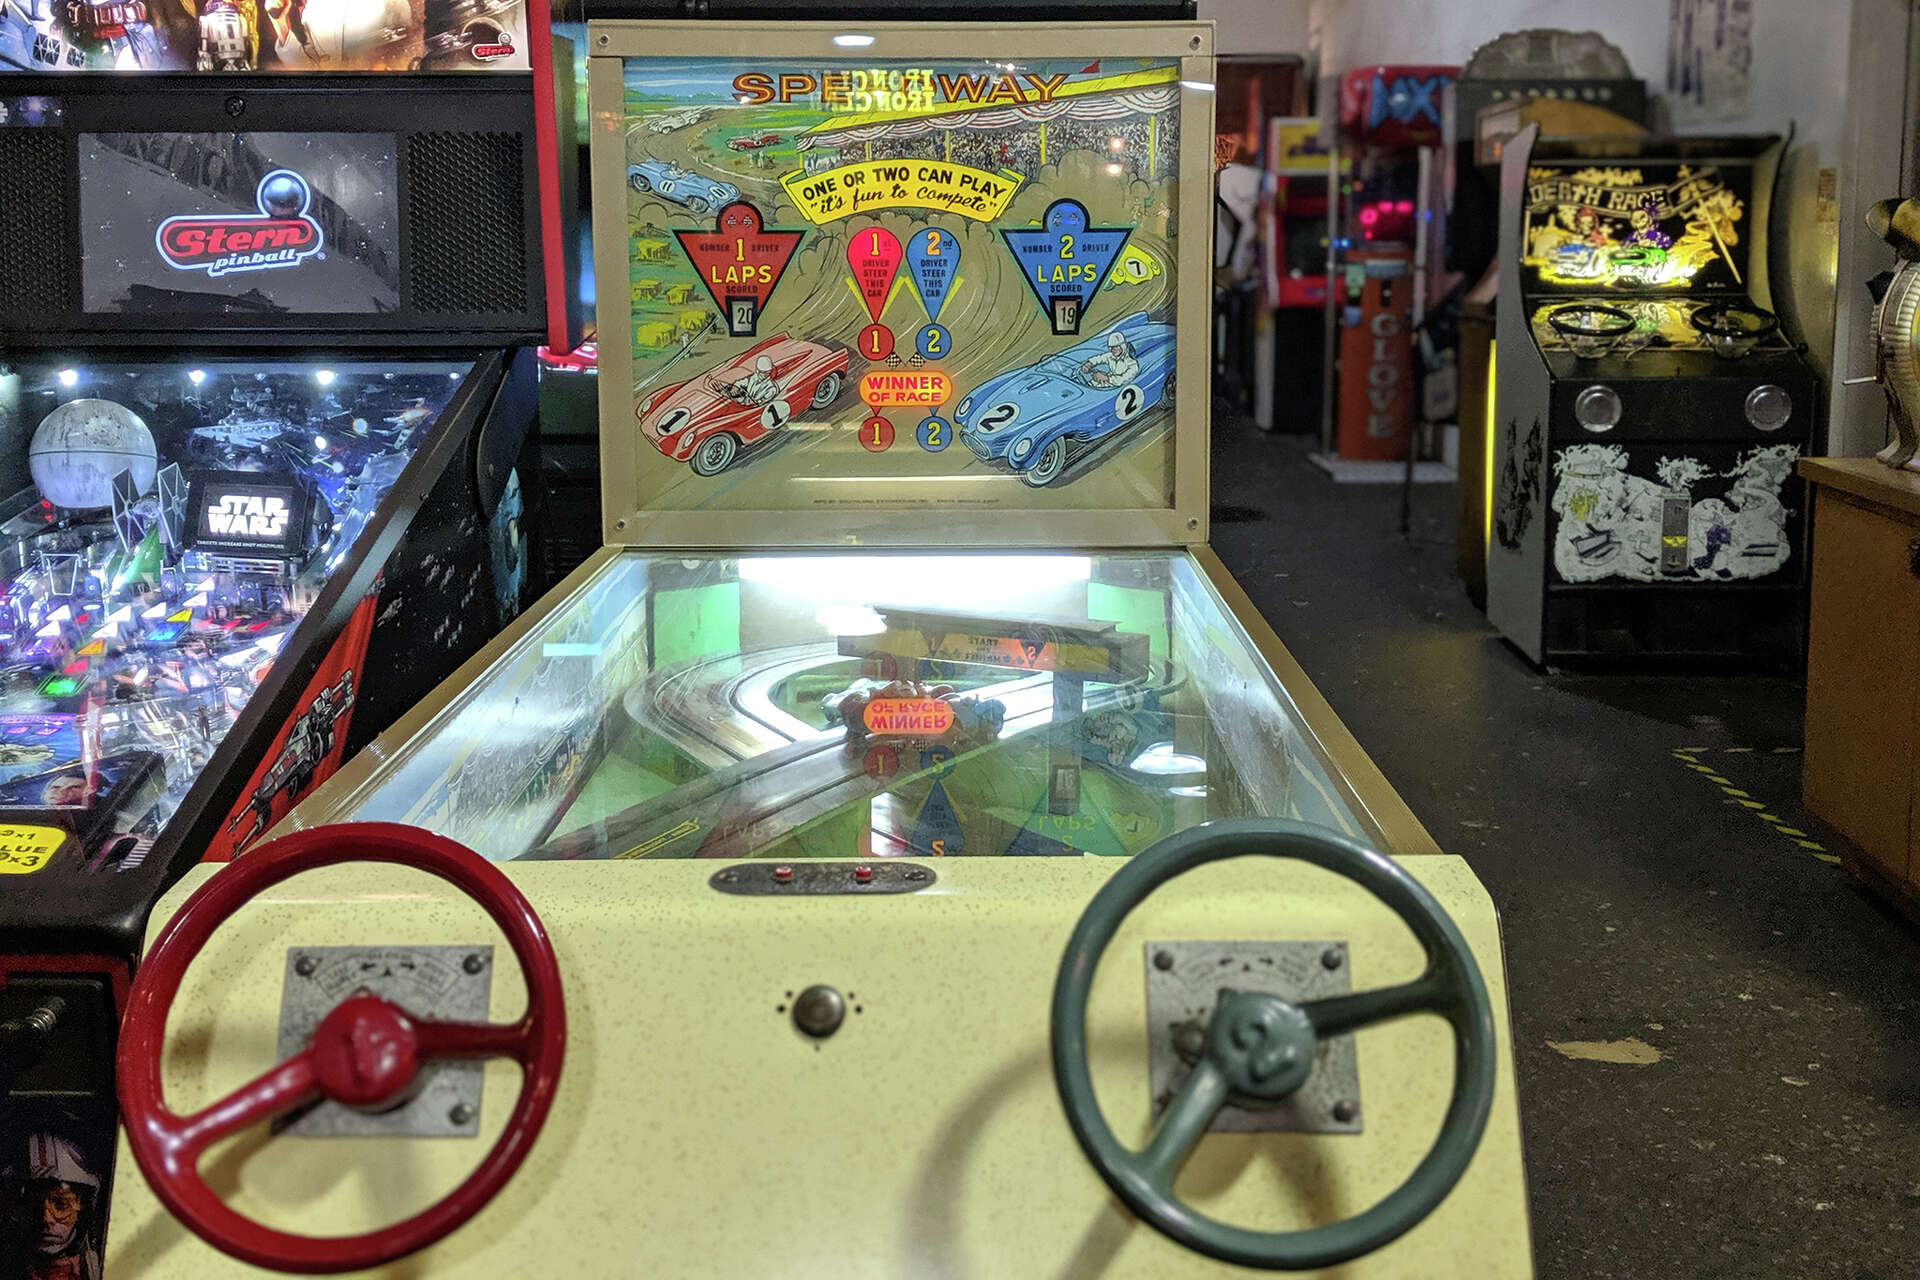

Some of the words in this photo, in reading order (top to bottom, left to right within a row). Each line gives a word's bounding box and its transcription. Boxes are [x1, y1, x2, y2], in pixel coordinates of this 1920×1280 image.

[475, 47, 513, 57] Stern
[731, 72, 1070, 106] SPEWAY
[802, 178, 837, 200] ONE
[843, 171, 865, 188] OR
[872, 167, 910, 182] TWO
[917, 167, 952, 184] CAN
[959, 174, 1006, 199] PLAY
[852, 188, 884, 211] fun
[891, 183, 909, 199] to
[1530, 181, 1602, 207] DEATH
[1608, 189, 1667, 211] RACE
[175, 227, 306, 258] Stern
[736, 238, 745, 262] 1
[1022, 245, 1053, 253] NUMBER
[1060, 234, 1074, 259] 2
[1082, 244, 1110, 252] DRIVER
[214, 249, 296, 269] pinball
[920, 259, 948, 267] DRIVER
[711, 265, 772, 283] LAPS
[864, 269, 887, 277] STEER
[865, 279, 884, 287] THIS
[921, 269, 945, 277] STEER
[924, 279, 942, 287] THIS
[1037, 264, 1097, 282] LAPS
[925, 289, 940, 297] CAR
[1050, 285, 1082, 293] SCORED
[737, 307, 753, 324] 20
[1061, 306, 1076, 324] 19
[871, 330, 880, 353] 1
[927, 329, 941, 353] 2
[866, 376, 943, 390] WINNER
[1368, 313, 1399, 439] GLOVE
[868, 392, 890, 402] OF
[895, 392, 942, 402] RACE
[1122, 388, 1138, 415] 2
[659, 410, 687, 434] 1
[767, 404, 783, 427] 1
[979, 404, 1015, 431] 2
[873, 422, 881, 445] 1
[927, 421, 941, 445] 2
[208, 495, 289, 516] STAR
[208, 513, 288, 536] WARS
